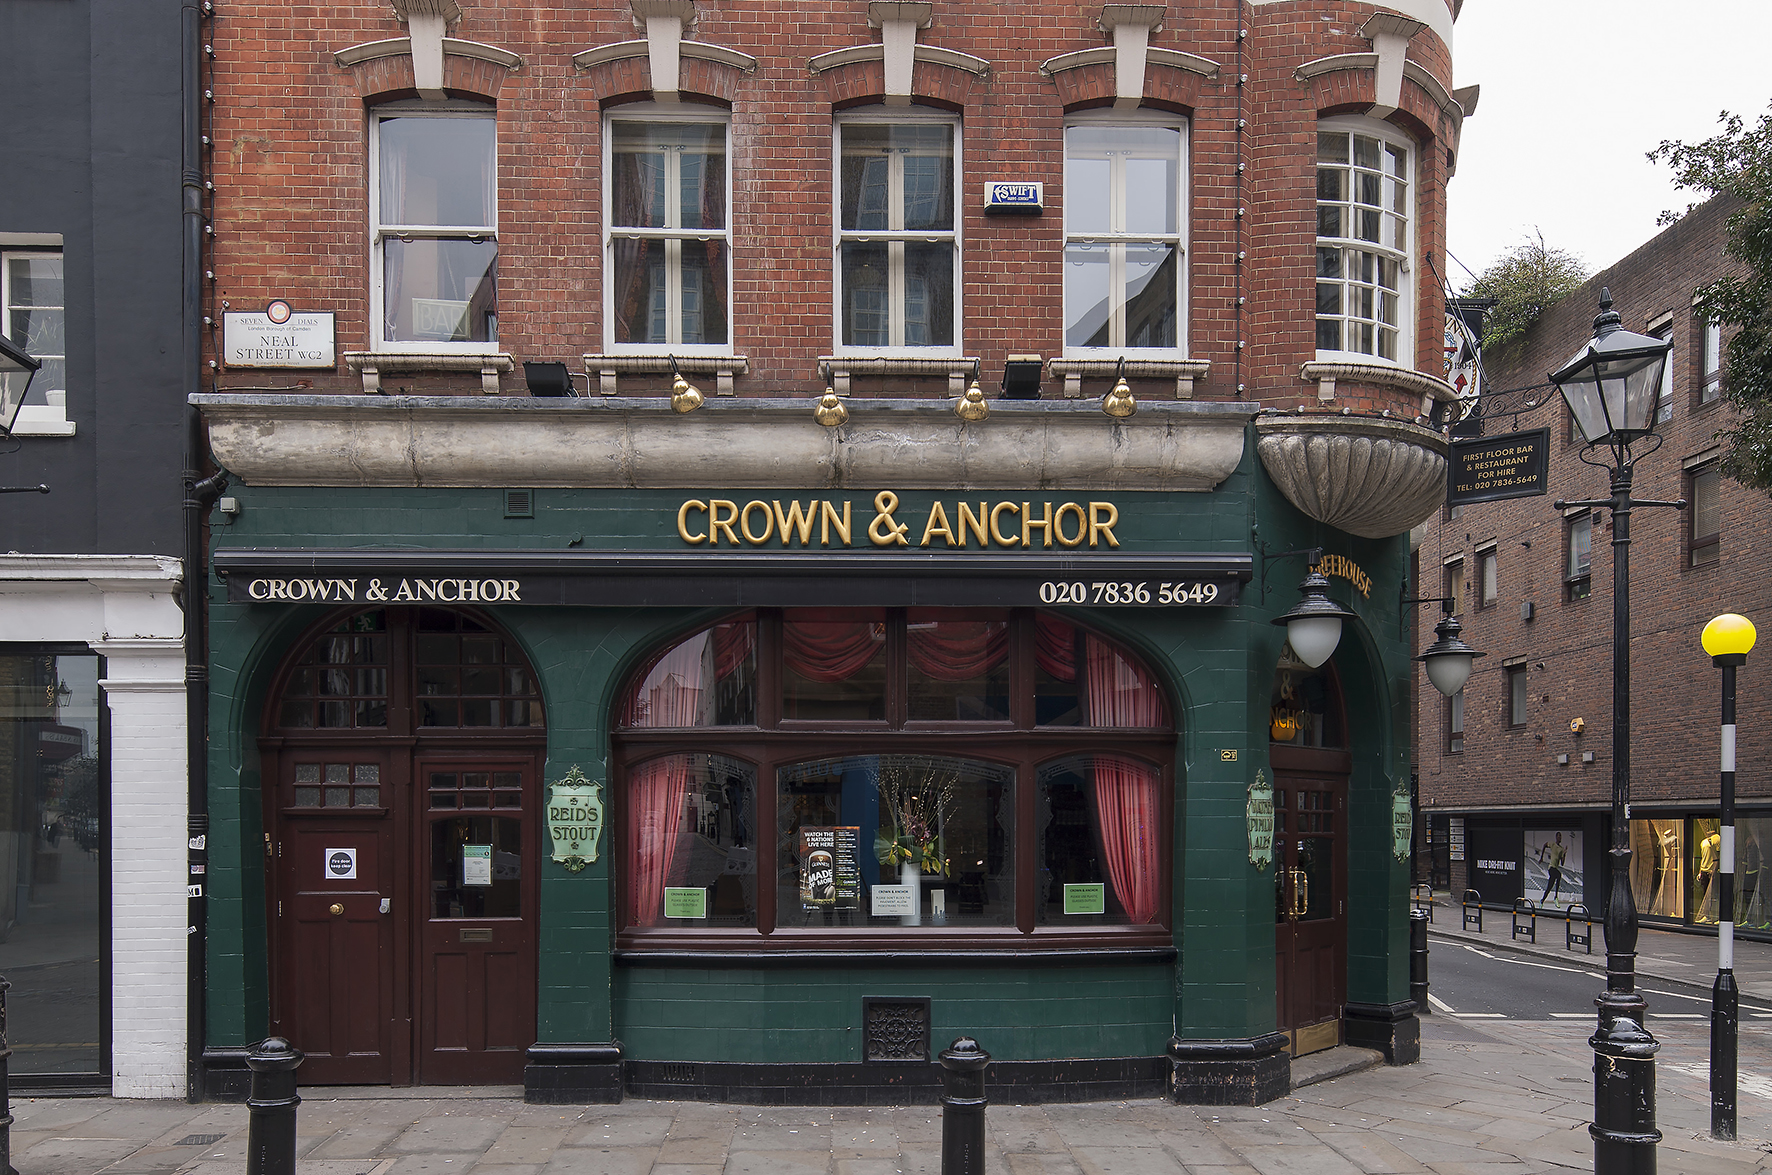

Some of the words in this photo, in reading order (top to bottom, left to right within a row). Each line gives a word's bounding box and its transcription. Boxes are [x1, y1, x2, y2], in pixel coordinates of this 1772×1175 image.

[1000, 185, 1036, 199] SWIFT
[420, 305, 464, 333] BAR
[260, 335, 298, 347] NEAL
[236, 348, 294, 360] STREET
[298, 351, 322, 360] WC2
[1462, 452, 1484, 462] FIRST
[1486, 448, 1515, 459] FLOOR
[1516, 444, 1534, 454] BAR
[1466, 464, 1473, 472] &
[1474, 455, 1529, 470] RESTAURANT
[1477, 471, 1495, 480] FOR
[1496, 467, 1516, 477] HIRE
[1456, 484, 1473, 492] TEL:
[1474, 481, 1490, 490] 020
[1492, 474, 1538, 487] 7836-5649
[676, 499, 852, 547] CROWN
[868, 490, 910, 547] &
[920, 500, 1121, 548] ANCHOR
[1309, 554, 1373, 600] REEHOUSE
[248, 578, 358, 601] CROWN
[365, 578, 389, 601] &
[391, 578, 522, 602] ANCHOR
[1038, 581, 1088, 604] 020
[1090, 582, 1151, 604] 7836
[1157, 582, 1219, 604] 5649
[1280, 669, 1294, 701] &
[1269, 706, 1312, 731] NCHOR
[549, 803, 599, 822] REID'S
[552, 826, 598, 841] STOUT
[1476, 859, 1488, 869] NIKE
[808, 869, 833, 882] MADE
[817, 877, 833, 886] MORE
